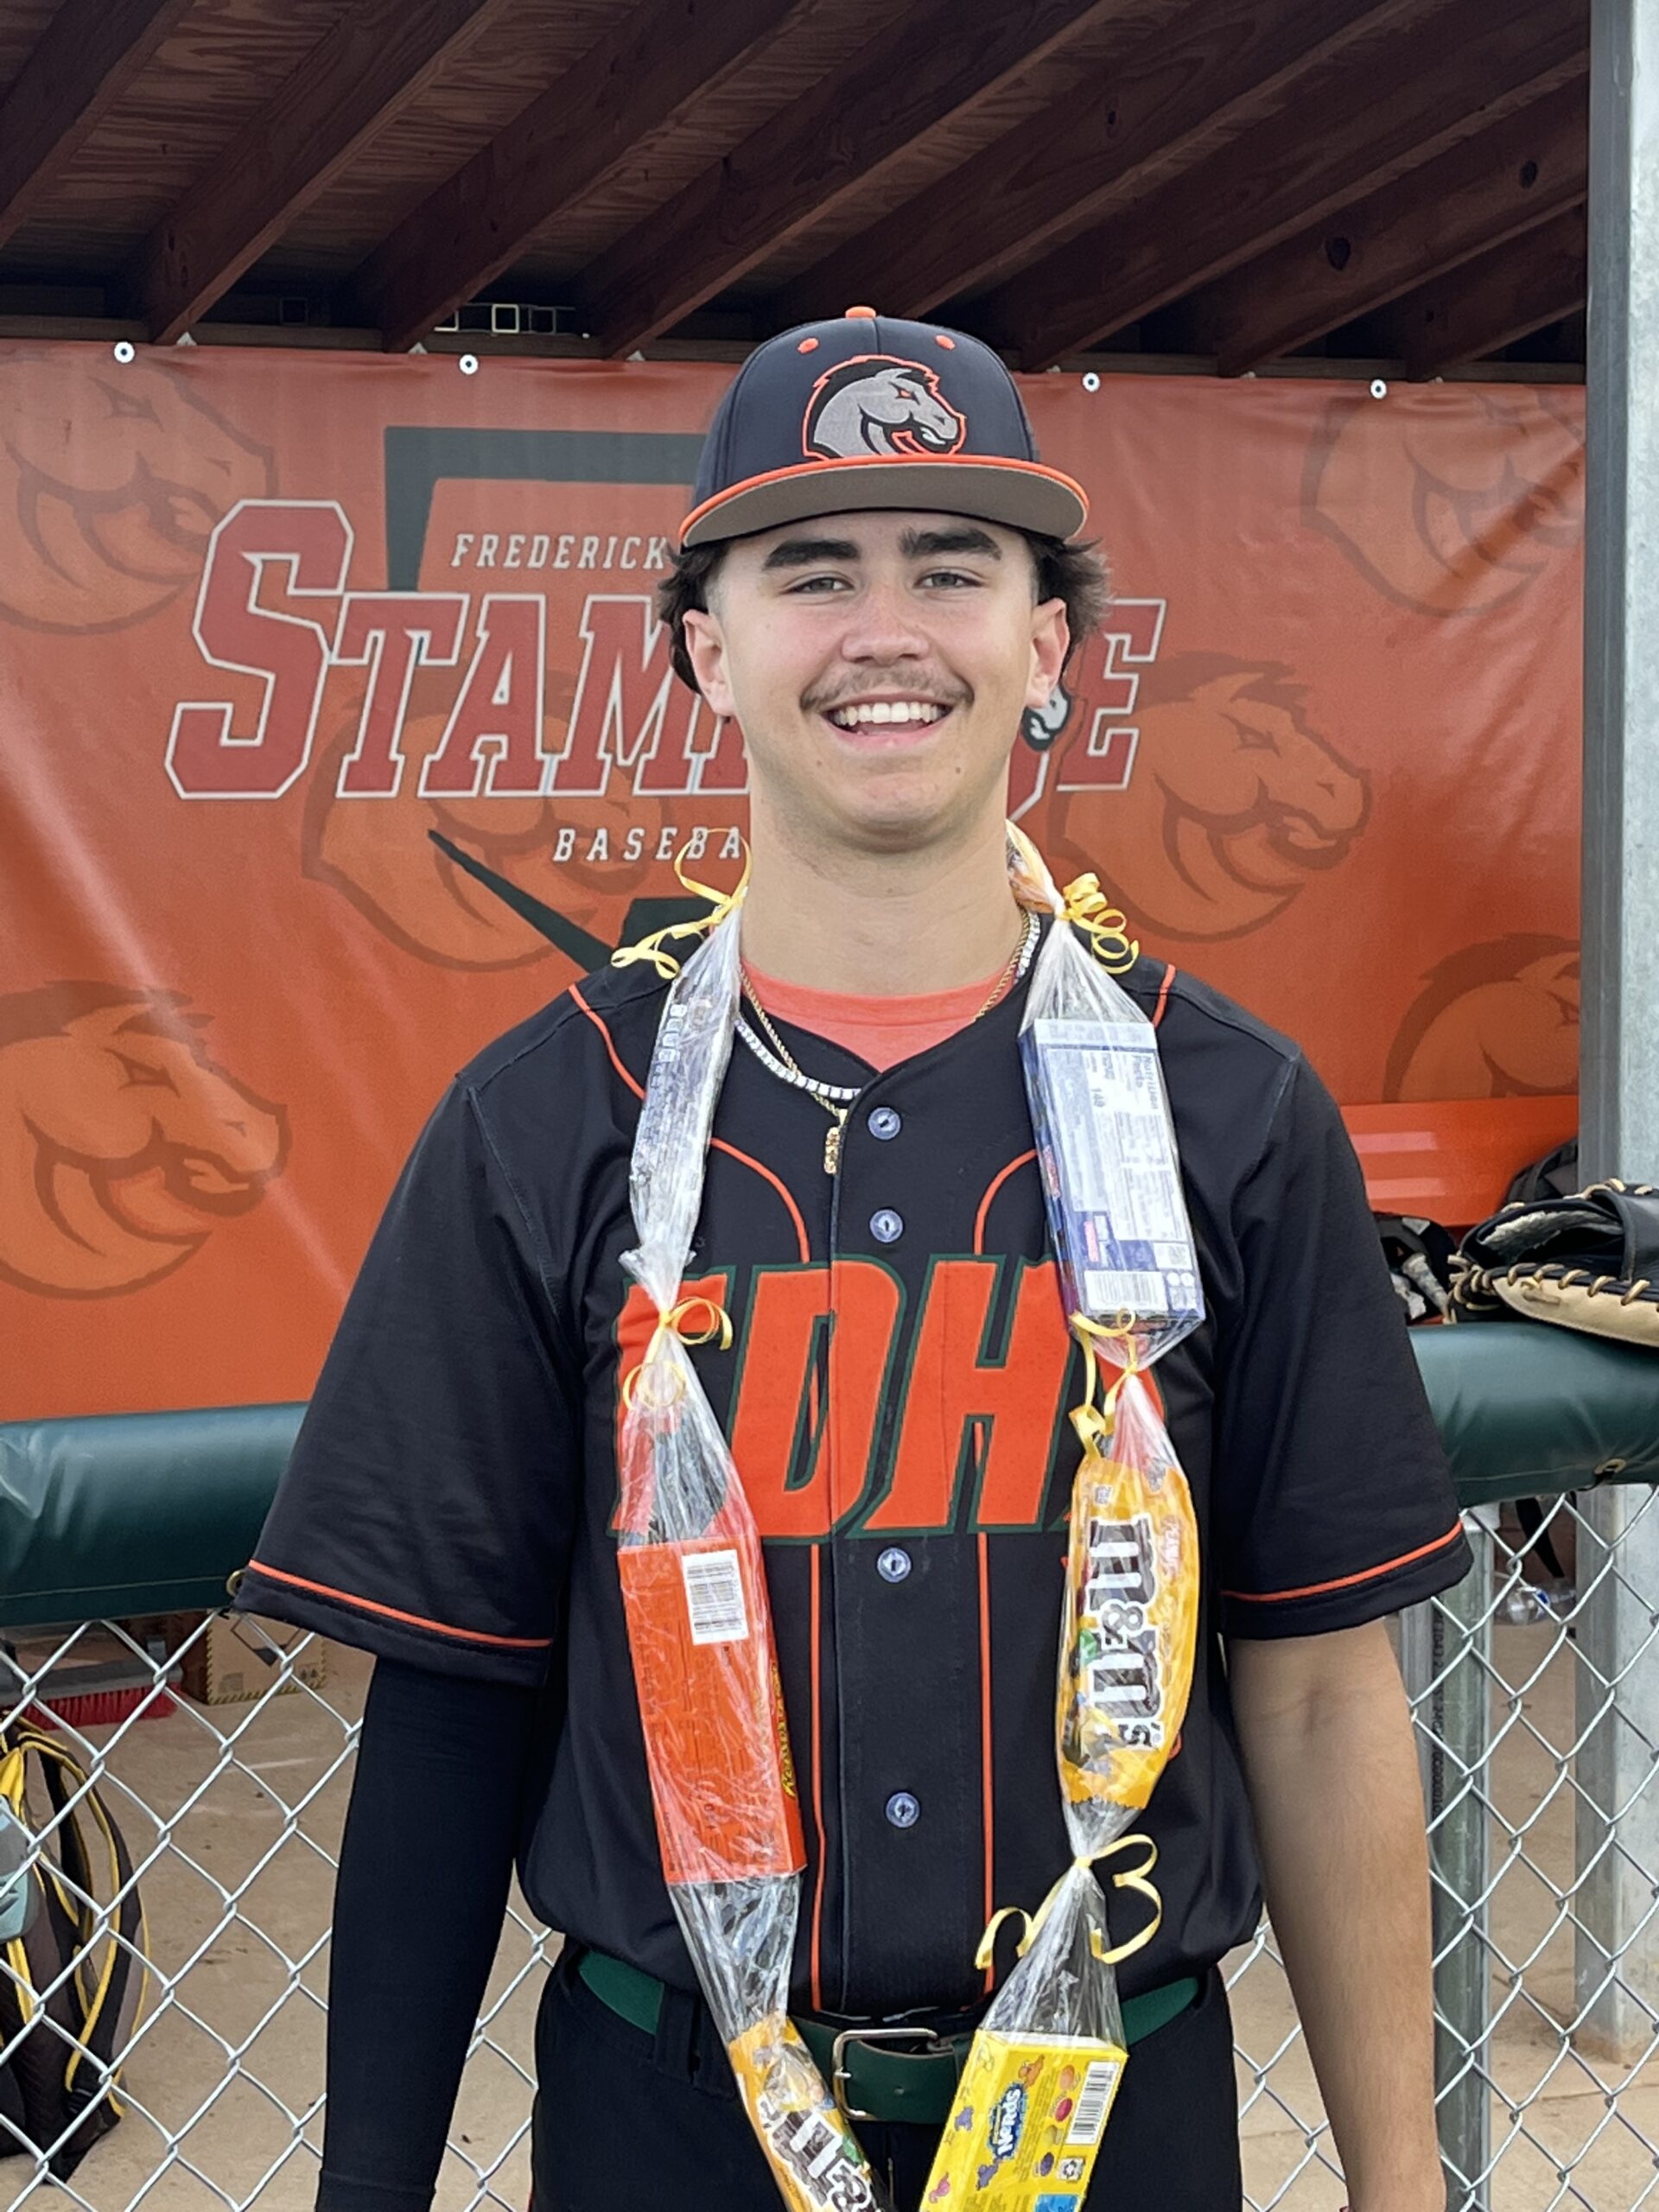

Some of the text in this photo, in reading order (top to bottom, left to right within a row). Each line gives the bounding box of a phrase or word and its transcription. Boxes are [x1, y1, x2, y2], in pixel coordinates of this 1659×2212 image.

[450, 533, 669, 570] FREDERICK
[552, 826, 741, 862] BASEBA
[607, 1253, 1168, 1547] FDH
